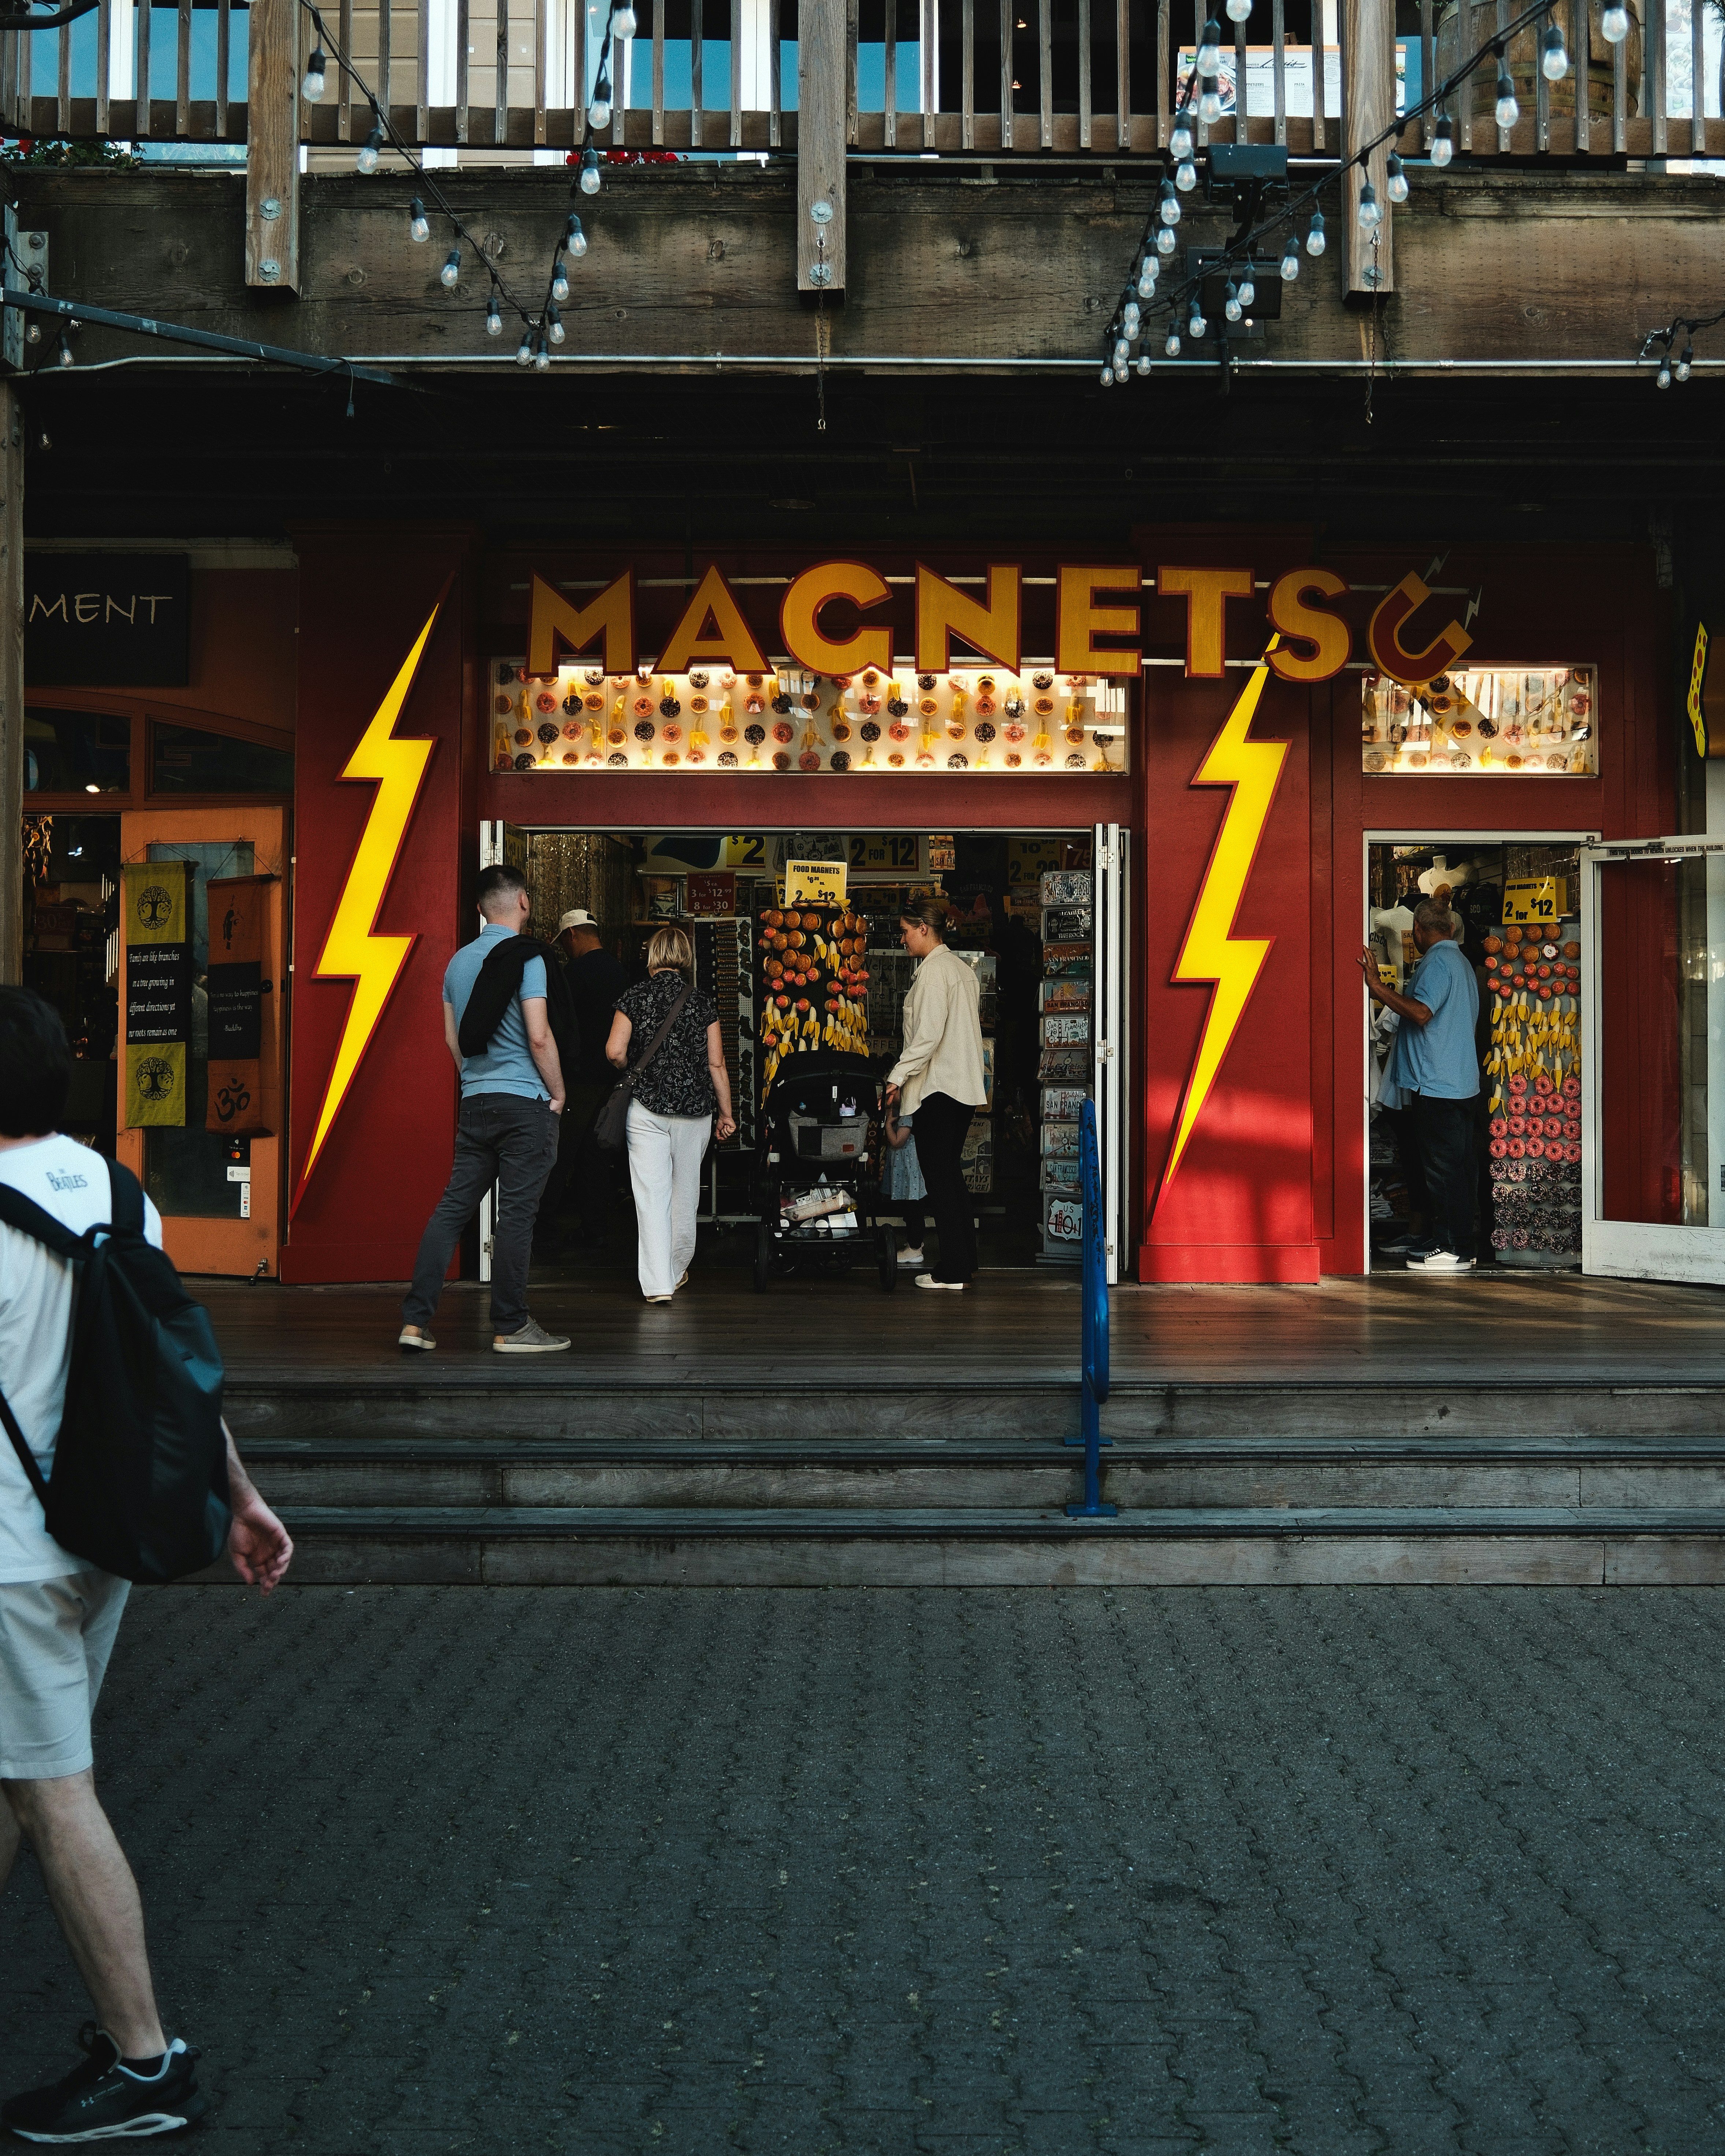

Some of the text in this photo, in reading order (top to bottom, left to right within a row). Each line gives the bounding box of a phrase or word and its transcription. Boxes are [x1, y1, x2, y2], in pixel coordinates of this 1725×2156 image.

[29, 593, 173, 624] MENT
[526, 560, 1353, 683] MAGNETS
[851, 836, 915, 866] 2 FOR $12
[811, 866, 840, 874] MAGNETS
[1009, 861, 1021, 882] 2
[691, 889, 697, 898] 3
[708, 888, 732, 897] $12.99
[795, 889, 836, 901] 2 $12
[1047, 881, 1090, 898] SAN FRANCISCO
[866, 893, 872, 903] 2
[883, 892, 897, 903] $10
[694, 902, 700, 910] 8
[713, 901, 729, 910] $30
[1504, 898, 1553, 920] 2 for $12
[1370, 932, 1387, 947] CISCO
[130, 952, 142, 965] Family
[149, 951, 157, 963] like
[159, 950, 179, 962] branches
[861, 959, 909, 971] Welcome
[149, 976, 168, 990] growing
[169, 976, 174, 986] in
[129, 1002, 145, 1016] different
[146, 1001, 168, 1012] directions
[135, 1029, 146, 1037] roots
[147, 1026, 162, 1037] remain
[1047, 1021, 1087, 1032] San Francisco
[865, 1040, 902, 1049] OFFEE
[1046, 1101, 1080, 1109] SAN FRANC
[1058, 1164, 1077, 1174] FRANCISCO
[46, 1171, 89, 1193] BEATLES
[1063, 1205, 1074, 1213] US
[1054, 1213, 1082, 1236] 101
